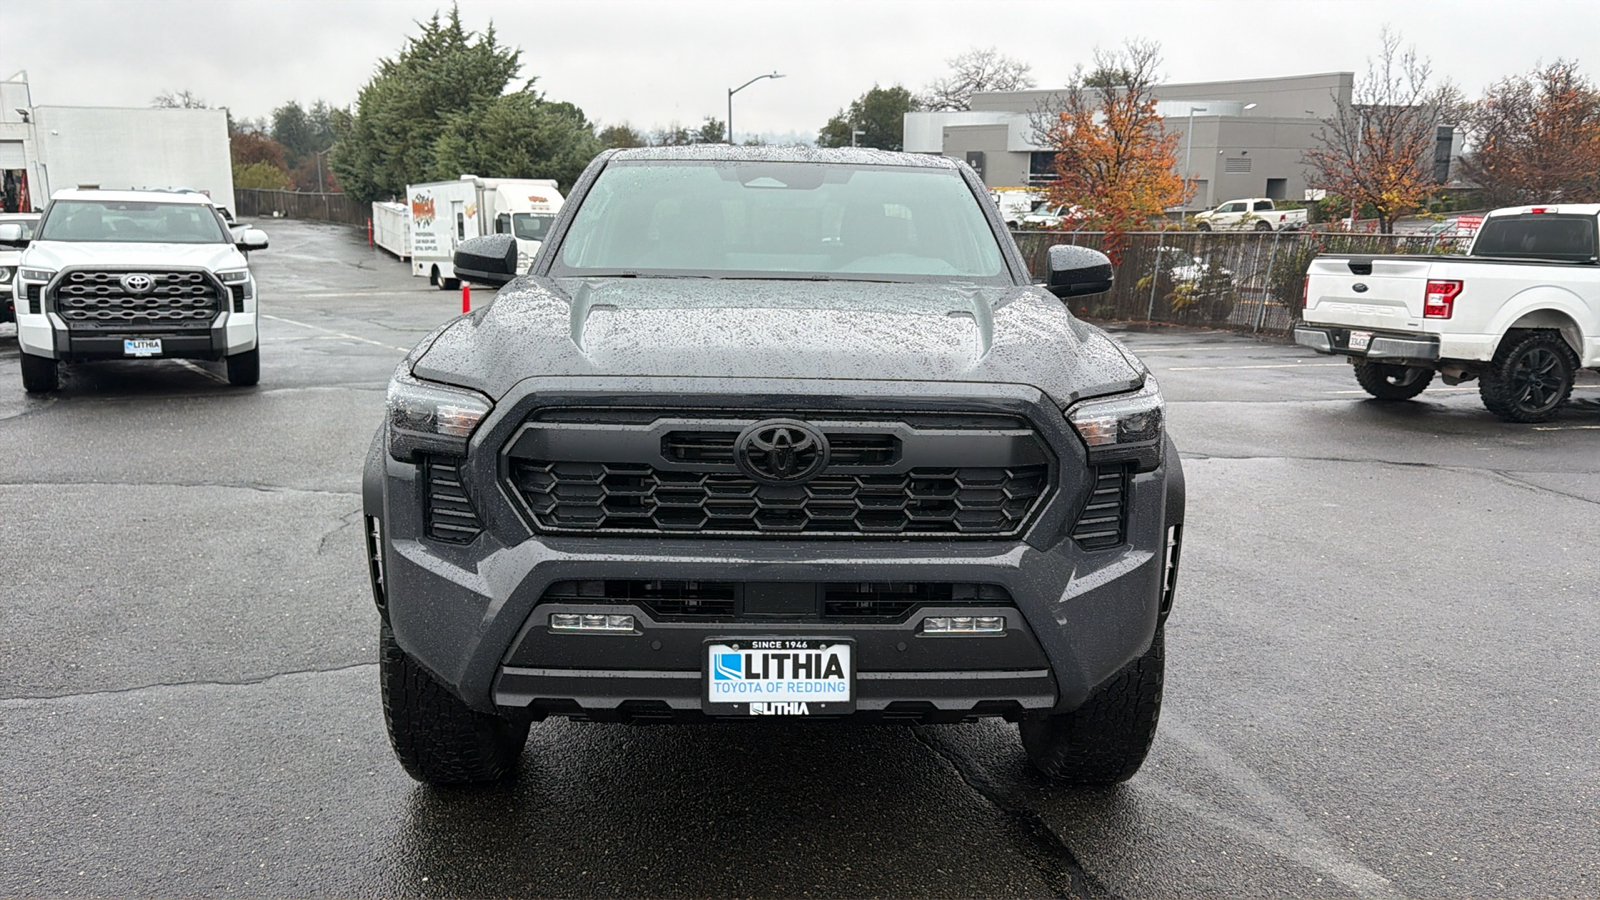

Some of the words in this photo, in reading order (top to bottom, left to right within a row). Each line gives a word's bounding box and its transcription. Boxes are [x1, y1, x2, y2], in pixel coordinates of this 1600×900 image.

[752, 641, 782, 649] SINCE
[785, 641, 808, 649] 1946
[745, 653, 845, 680] LITHIA
[714, 682, 763, 693] TOYOTA
[766, 682, 783, 693] OF
[787, 682, 846, 693] REDDING
[764, 702, 809, 715] LITHIA
